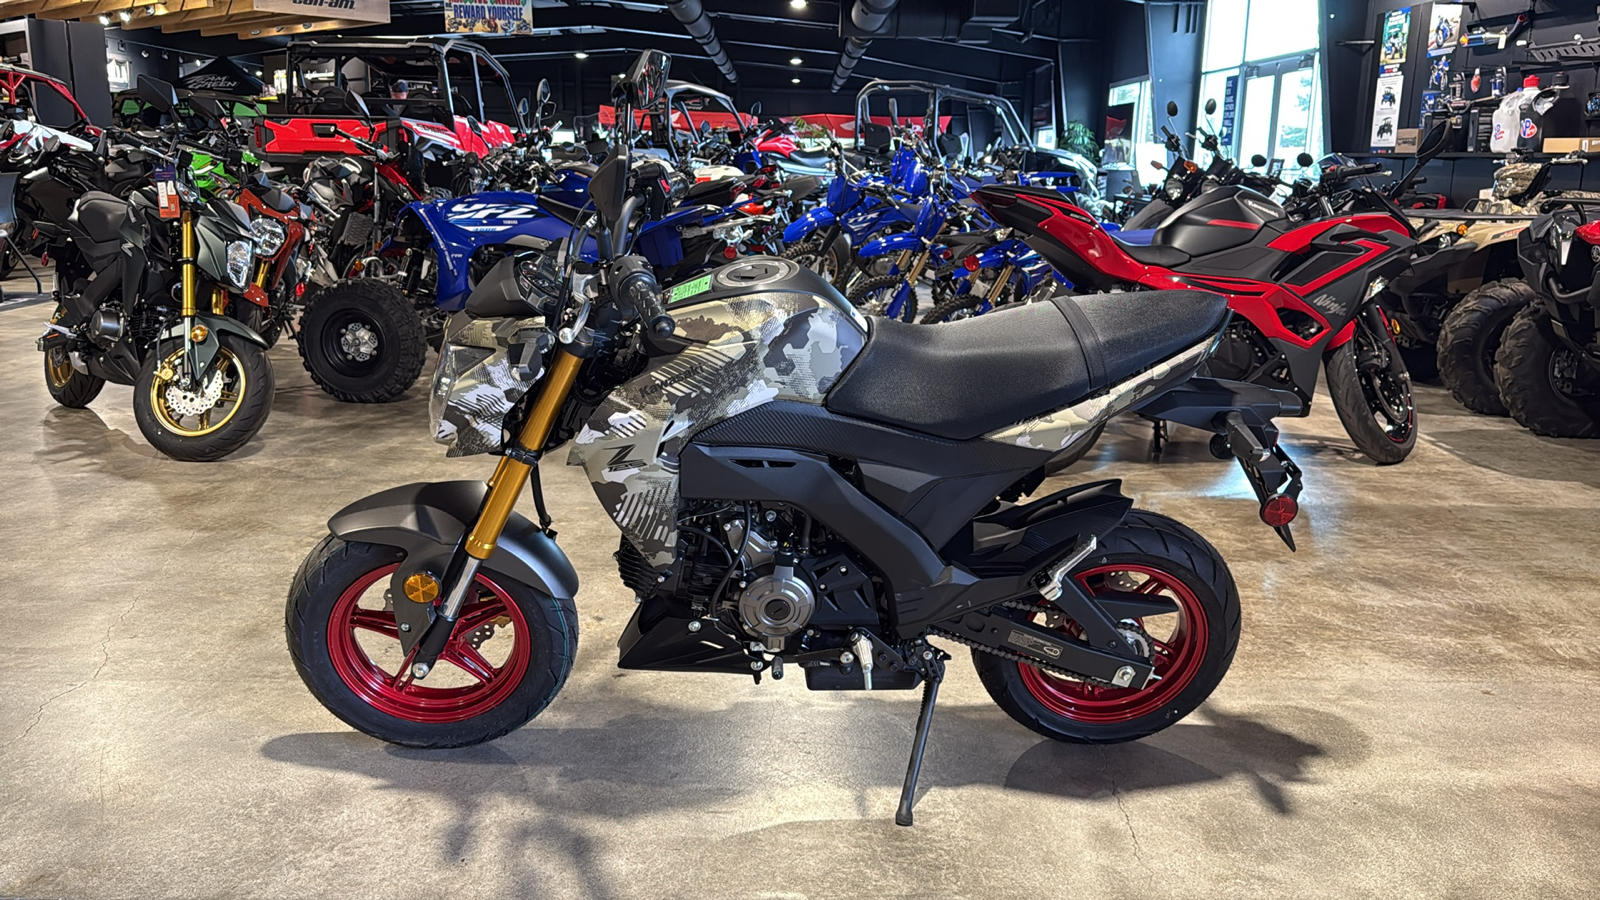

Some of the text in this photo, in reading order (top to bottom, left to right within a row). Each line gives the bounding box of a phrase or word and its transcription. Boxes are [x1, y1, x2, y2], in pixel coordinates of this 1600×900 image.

[453, 4, 523, 21] REWARD YOURSELF
[188, 81, 238, 89] GREEN
[447, 203, 539, 219] YFZ
[1312, 294, 1347, 316] Ninja
[639, 362, 704, 398] Kawasaki
[603, 444, 644, 466] Z
